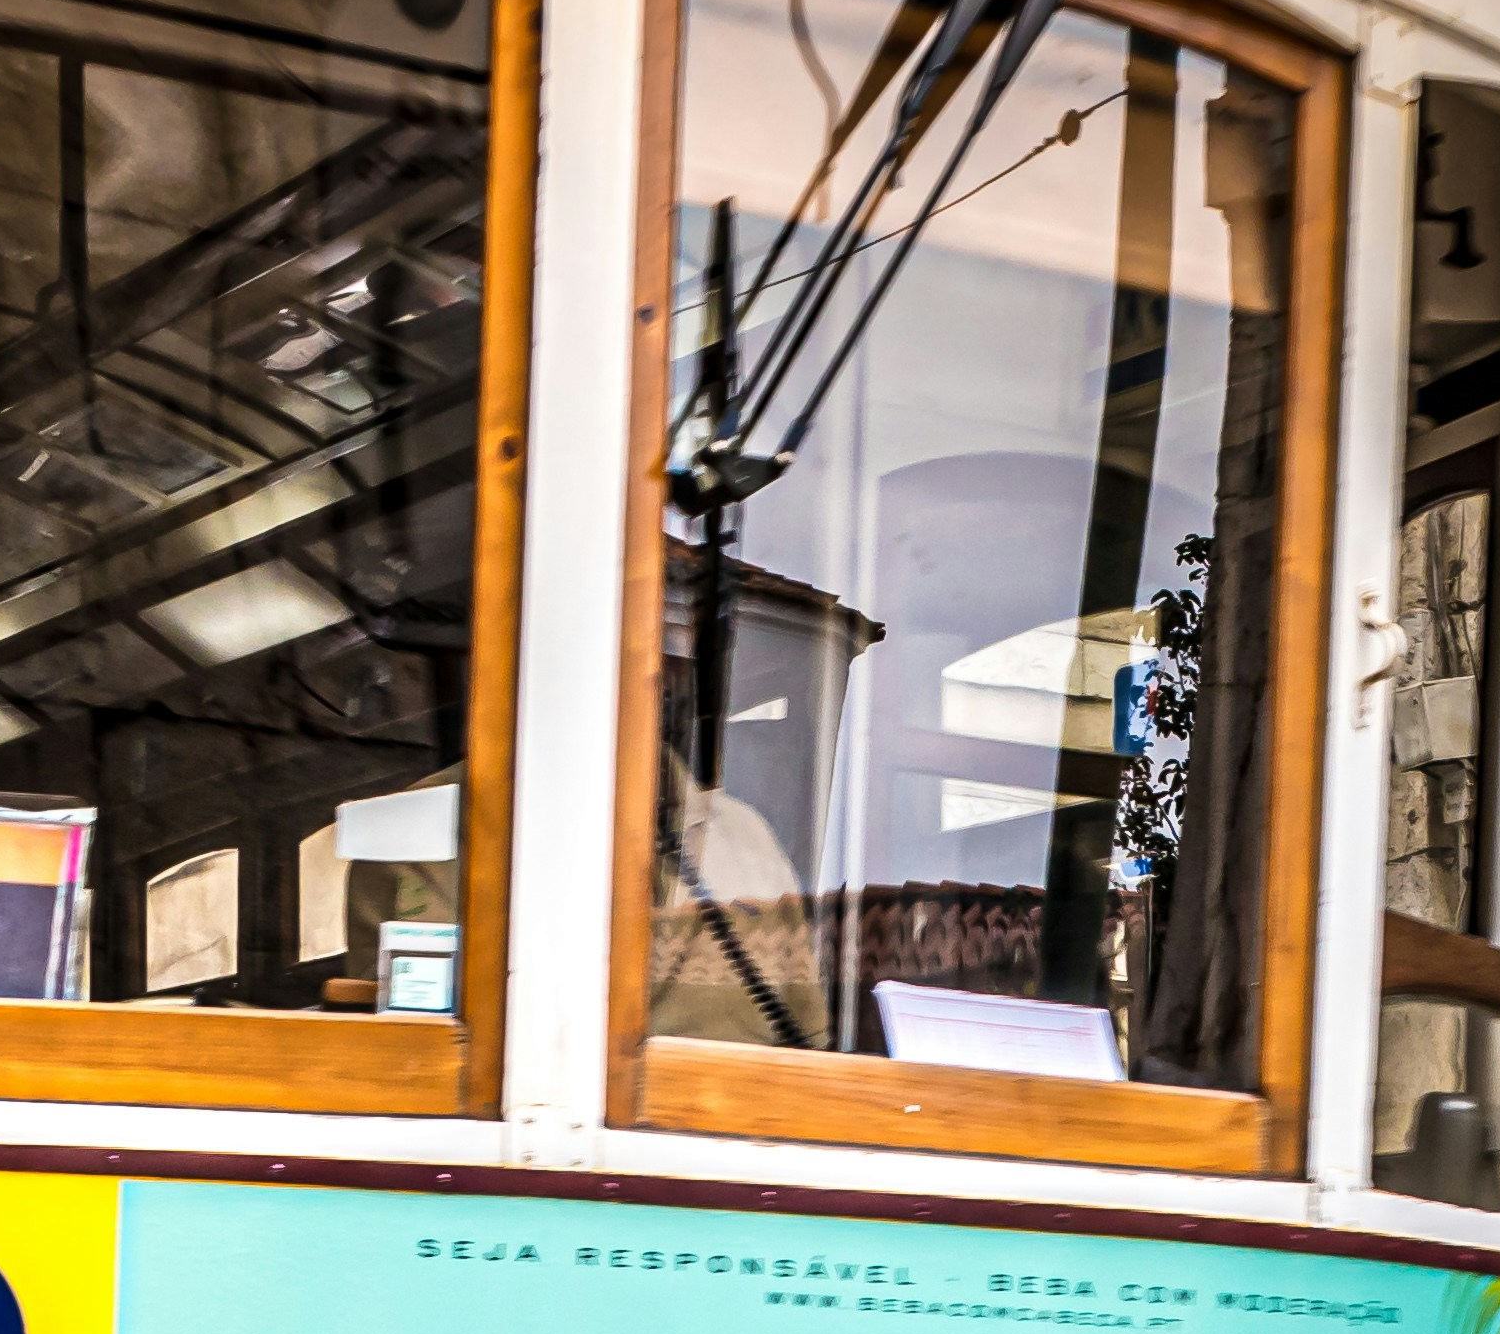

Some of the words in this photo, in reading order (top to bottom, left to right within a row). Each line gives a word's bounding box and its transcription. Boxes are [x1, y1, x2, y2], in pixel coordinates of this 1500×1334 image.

[414, 1238, 542, 1262] SEJA
[574, 1247, 918, 1286] RESPONSÁVEL
[988, 1273, 1096, 1296] BEBA
